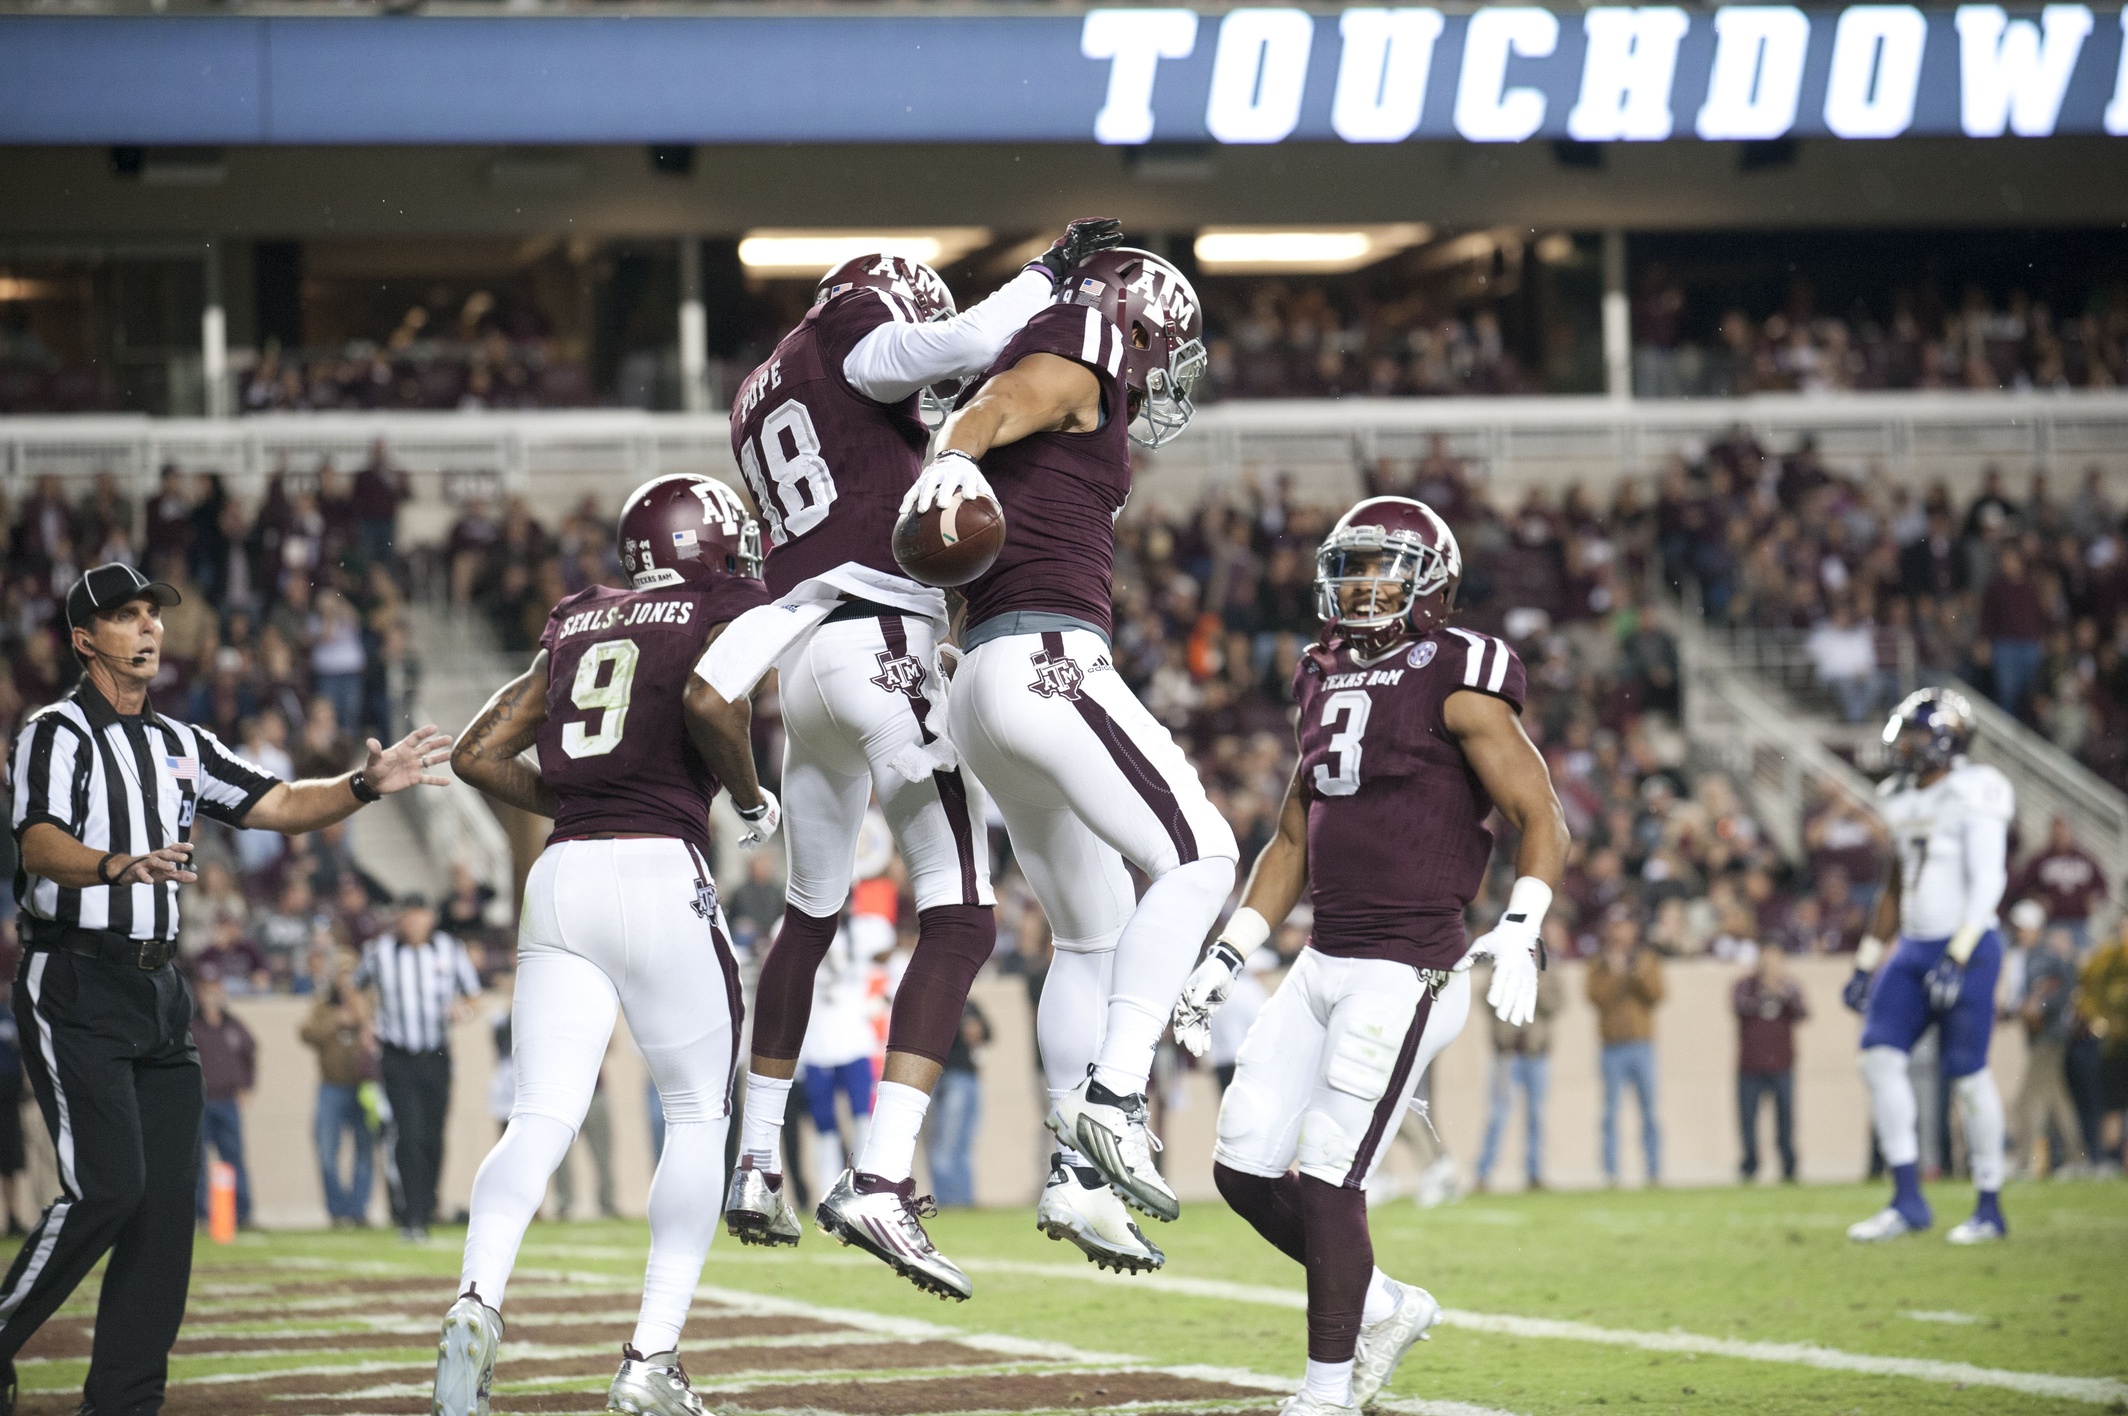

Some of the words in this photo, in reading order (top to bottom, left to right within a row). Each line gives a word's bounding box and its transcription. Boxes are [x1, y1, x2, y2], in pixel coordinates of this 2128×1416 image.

[1081, 5, 2128, 143] TOUCHDOW
[741, 358, 782, 424] POPE
[741, 398, 838, 547] 18
[560, 601, 694, 639] SEALS-JONES
[635, 575, 657, 586] TEXAS
[562, 639, 640, 759] 9
[1321, 671, 1368, 692] TEXAS
[1366, 669, 1405, 686] A&M
[1313, 690, 1372, 796] 3
[179, 800, 192, 827] B
[1359, 1299, 1421, 1395] adizero
